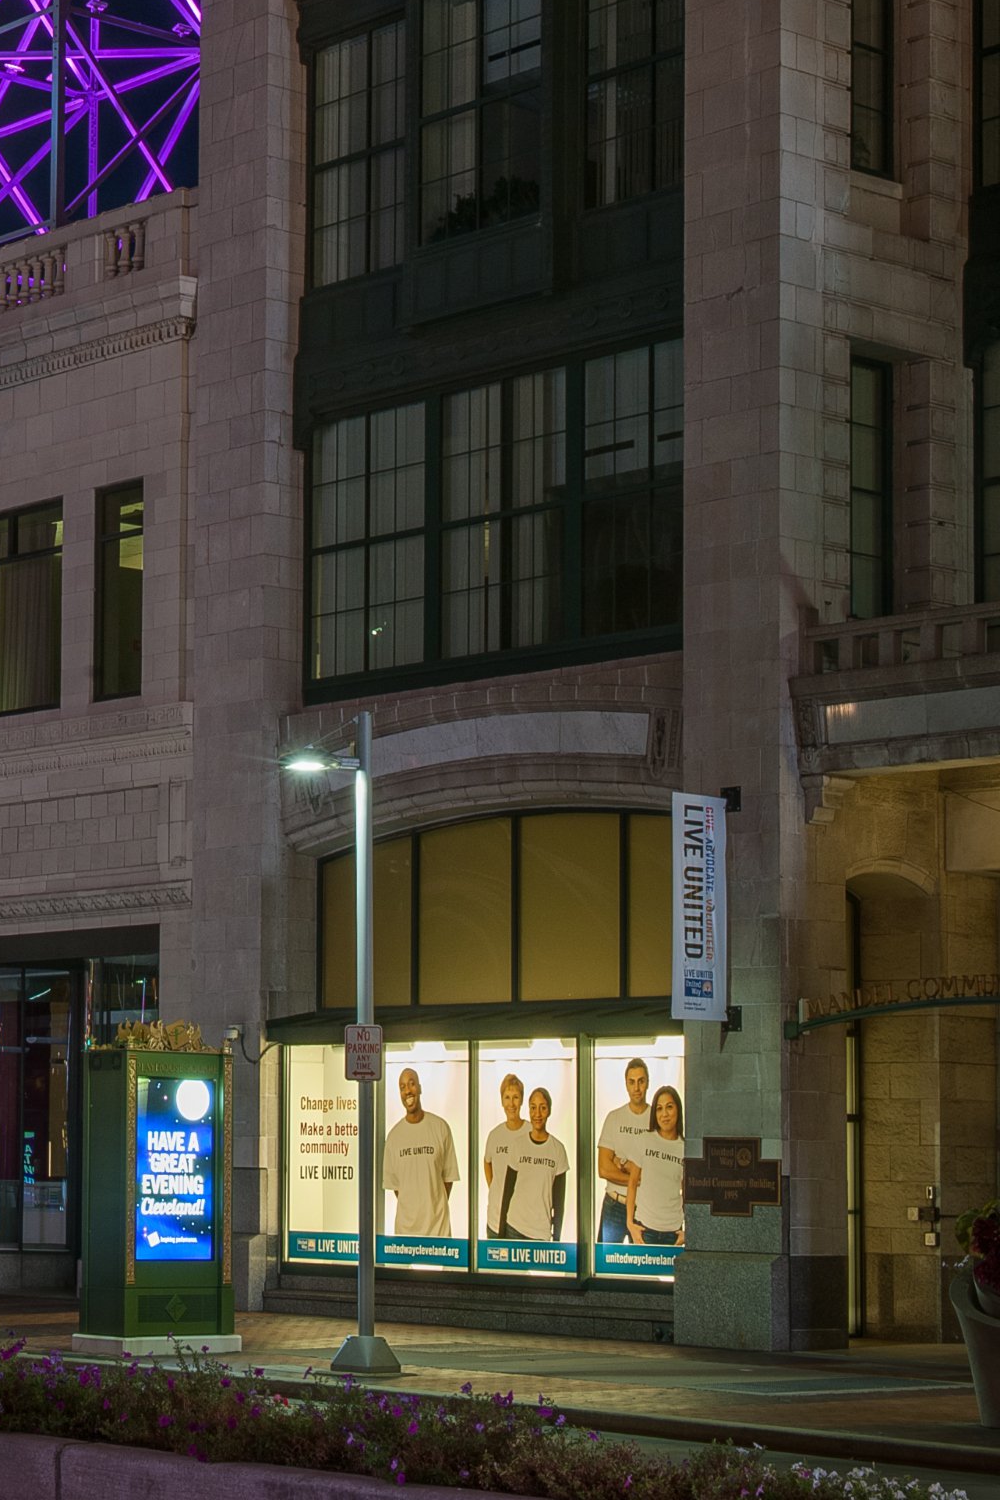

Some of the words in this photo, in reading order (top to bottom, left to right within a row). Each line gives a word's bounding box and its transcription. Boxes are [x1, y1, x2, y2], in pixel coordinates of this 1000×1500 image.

[684, 804, 703, 858] LIVE
[806, 982, 899, 1018] MANDEL
[357, 1031, 370, 1041] NO
[348, 1043, 379, 1054] PARKING
[356, 1062, 371, 1070] TIME
[300, 1096, 333, 1113] Change
[336, 1096, 357, 1110] lives
[300, 1122, 324, 1136] Make
[326, 1125, 332, 1136] a
[334, 1122, 358, 1136] bette
[620, 1126, 633, 1134] LIVE
[147, 1130, 186, 1151] HAVE
[187, 1131, 200, 1152] A
[300, 1140, 350, 1156] community
[399, 1149, 412, 1157] LIVE
[413, 1146, 435, 1155] UNITED
[496, 1146, 509, 1154] LIVE
[645, 1148, 660, 1158] LIVE
[150, 1153, 197, 1173] GREAT
[519, 1156, 532, 1164] LIVE
[533, 1157, 556, 1168] UNITED
[300, 1165, 319, 1179] LIVE
[322, 1165, 354, 1180] UNITED
[141, 1174, 205, 1195] EVENING
[141, 1197, 206, 1216] Cleveland!
[318, 1239, 335, 1253] LIVE
[337, 1240, 360, 1254] UNITE
[384, 1243, 459, 1259] unitedwaycleveland.org
[511, 1248, 531, 1263] LIVE
[533, 1249, 566, 1264] UNITED
